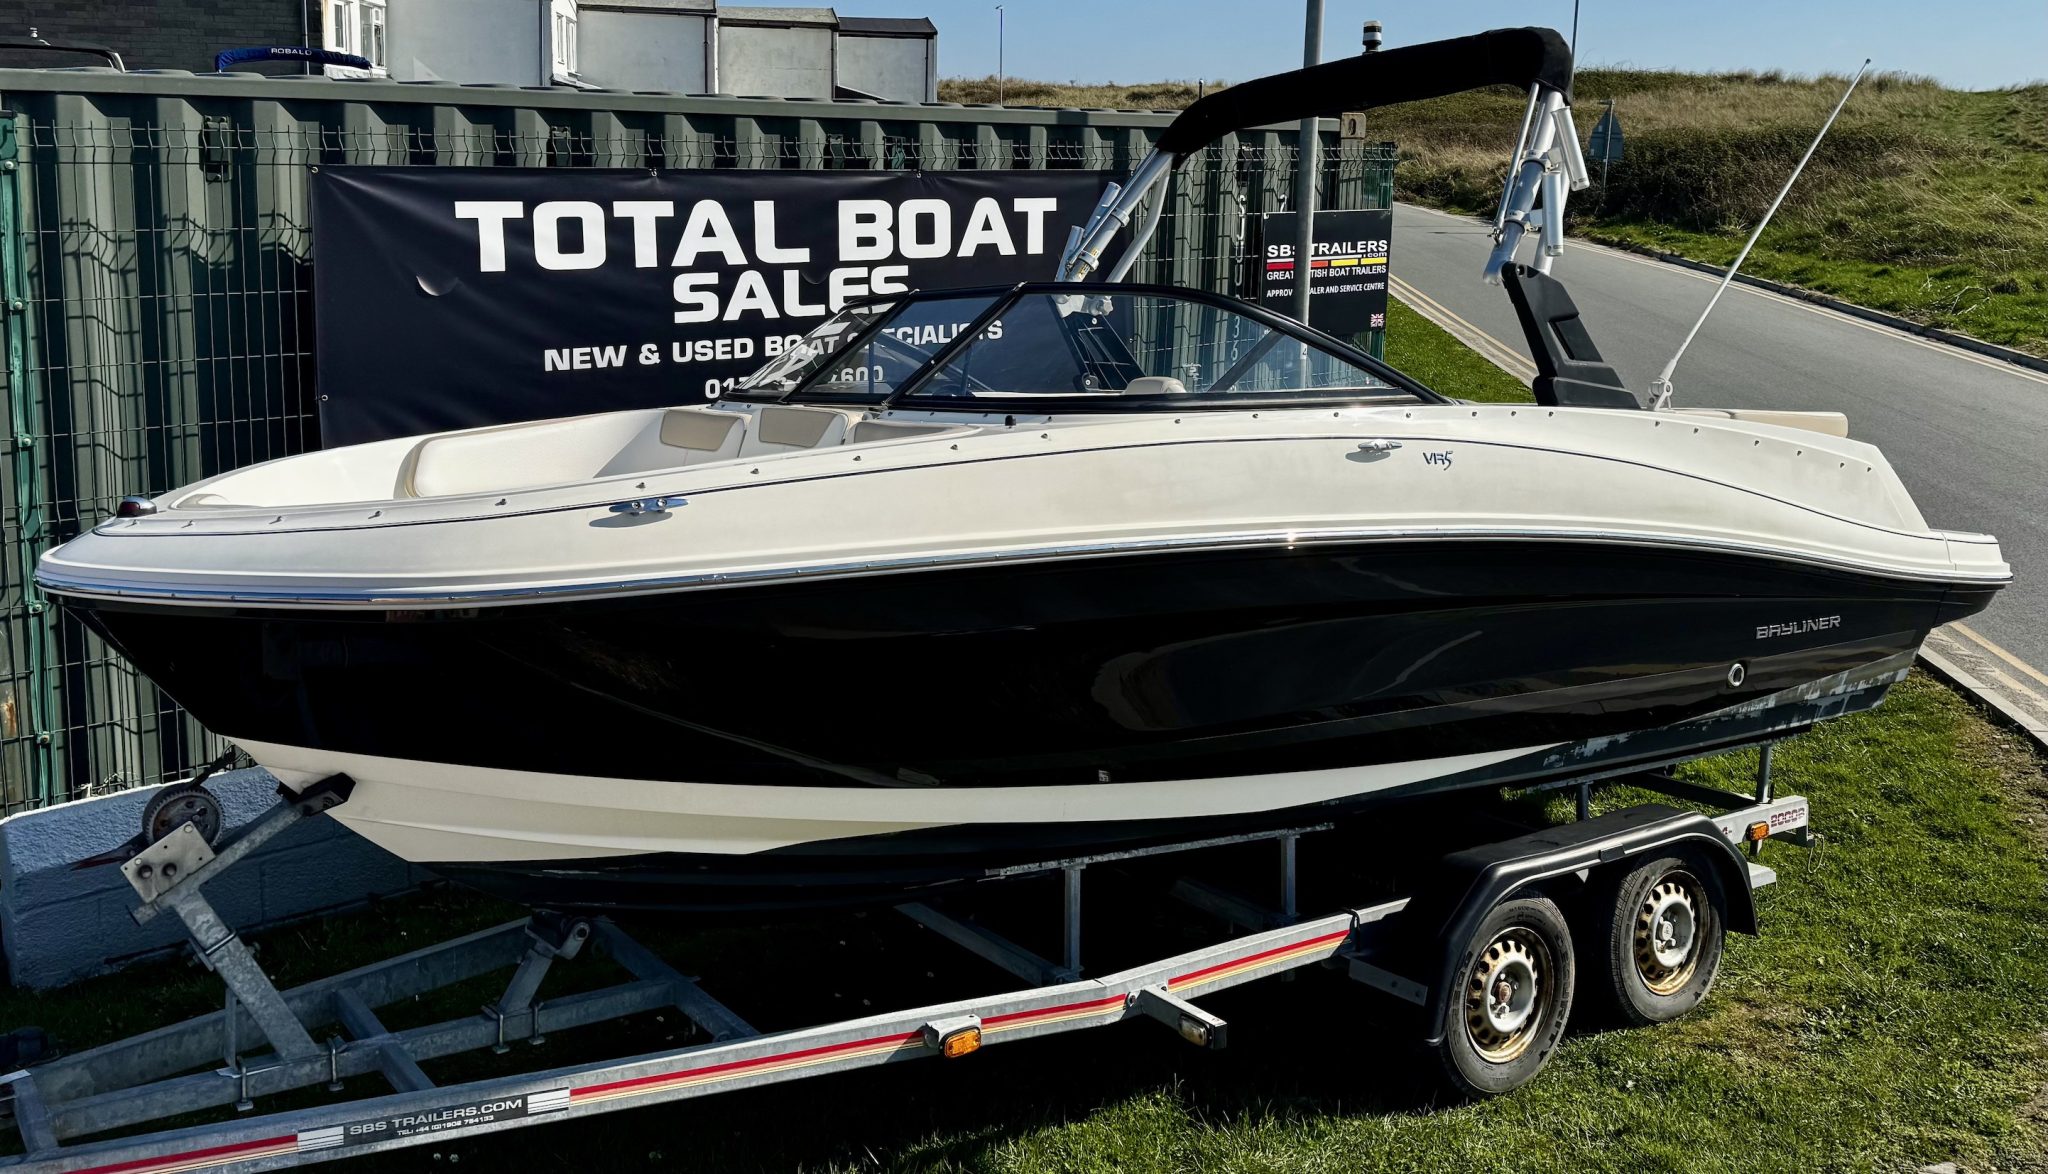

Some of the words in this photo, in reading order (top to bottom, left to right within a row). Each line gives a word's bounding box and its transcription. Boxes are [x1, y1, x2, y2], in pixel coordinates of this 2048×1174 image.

[454, 199, 810, 272] TOTAL
[838, 196, 1057, 262] BOAT
[1309, 239, 1388, 256] TRAILERS
[1309, 268, 1328, 278] TISH
[1329, 267, 1351, 277] BOAT
[1352, 264, 1387, 276] TRAILERS
[673, 264, 909, 324] SALES
[1266, 288, 1293, 298] APPROV
[1309, 286, 1325, 295] ALER
[1325, 285, 1340, 294] AND
[1340, 283, 1363, 293] SERVICE
[1363, 282, 1385, 291] CENTRE
[544, 345, 628, 372] NEW
[638, 343, 661, 365] &
[672, 337, 754, 363] USED
[1422, 450, 1454, 471] VR5
[1755, 615, 1841, 640] BAYLINER
[350, 1120, 387, 1136] SBS
[392, 1099, 523, 1127] TRAILERS.COM
